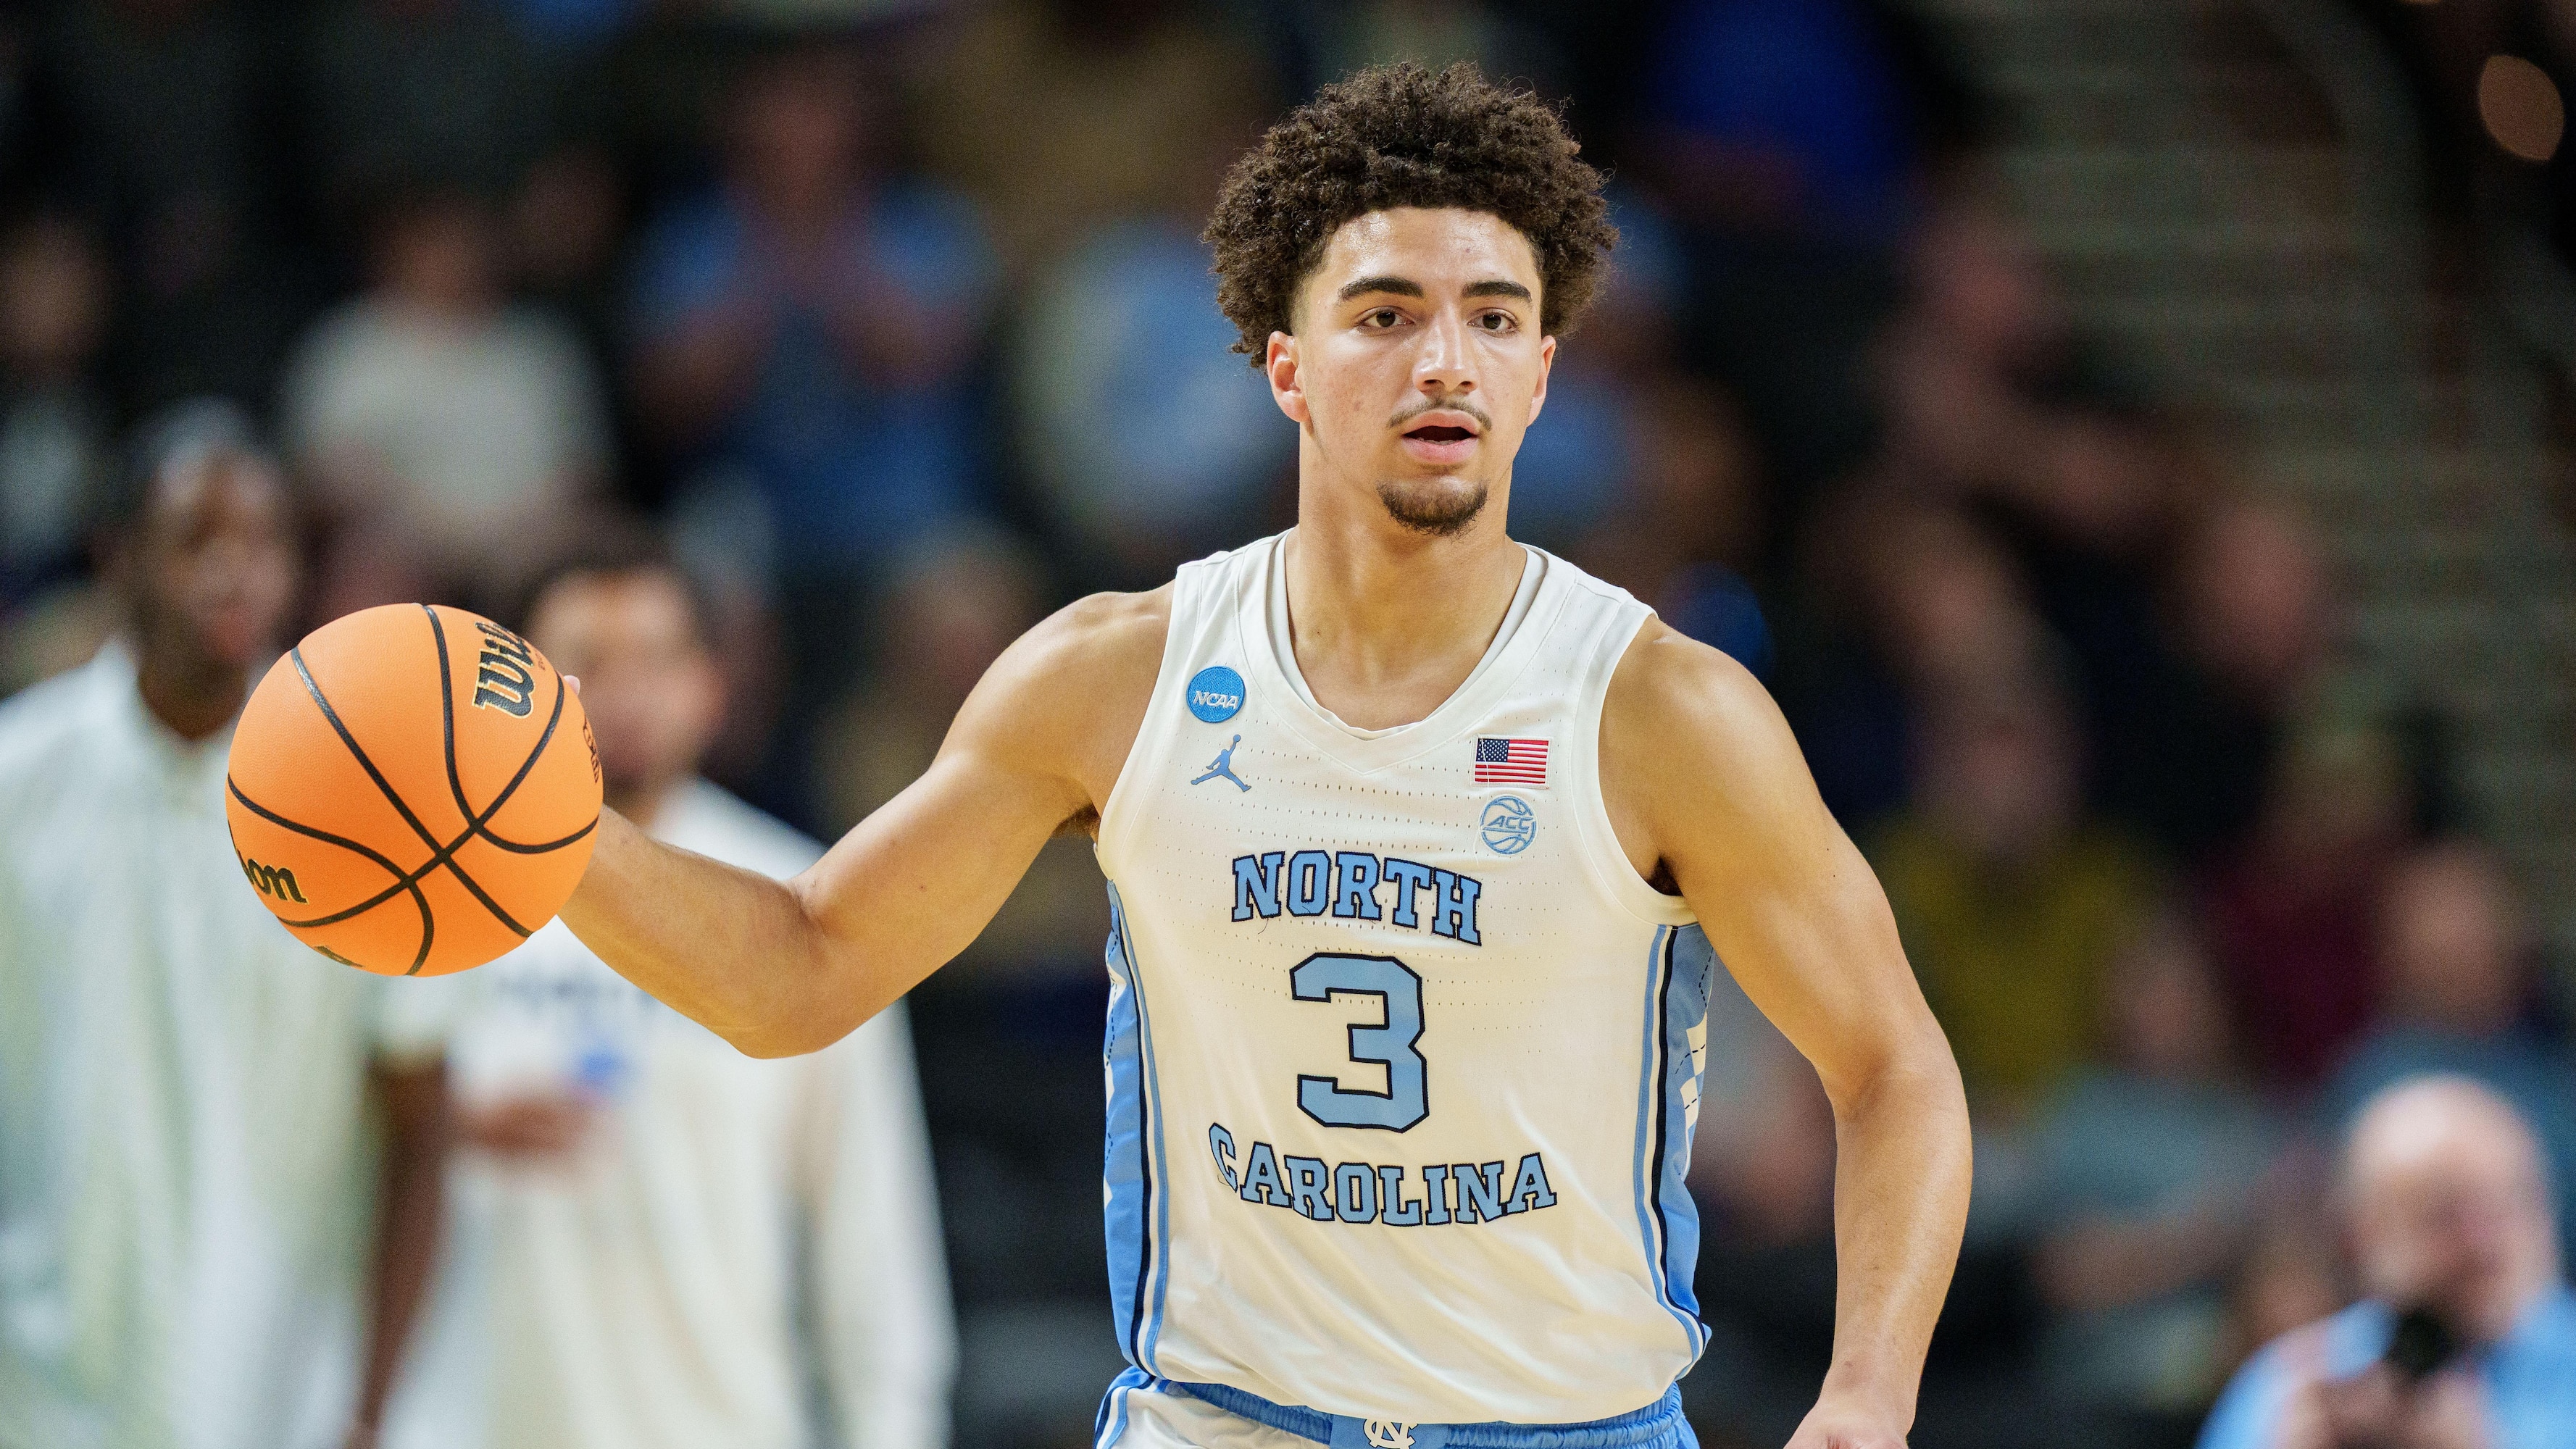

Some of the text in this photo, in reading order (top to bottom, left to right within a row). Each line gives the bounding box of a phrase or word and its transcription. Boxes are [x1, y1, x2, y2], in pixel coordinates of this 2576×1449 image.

[472, 619, 535, 719] Wil
[1193, 690, 1239, 710] NCAA
[1488, 815, 1533, 830] ACC
[238, 848, 309, 905] on
[1232, 850, 1482, 946] NORTH
[1290, 952, 1430, 1133] 3
[1209, 1123, 1557, 1226] CAROLINA
